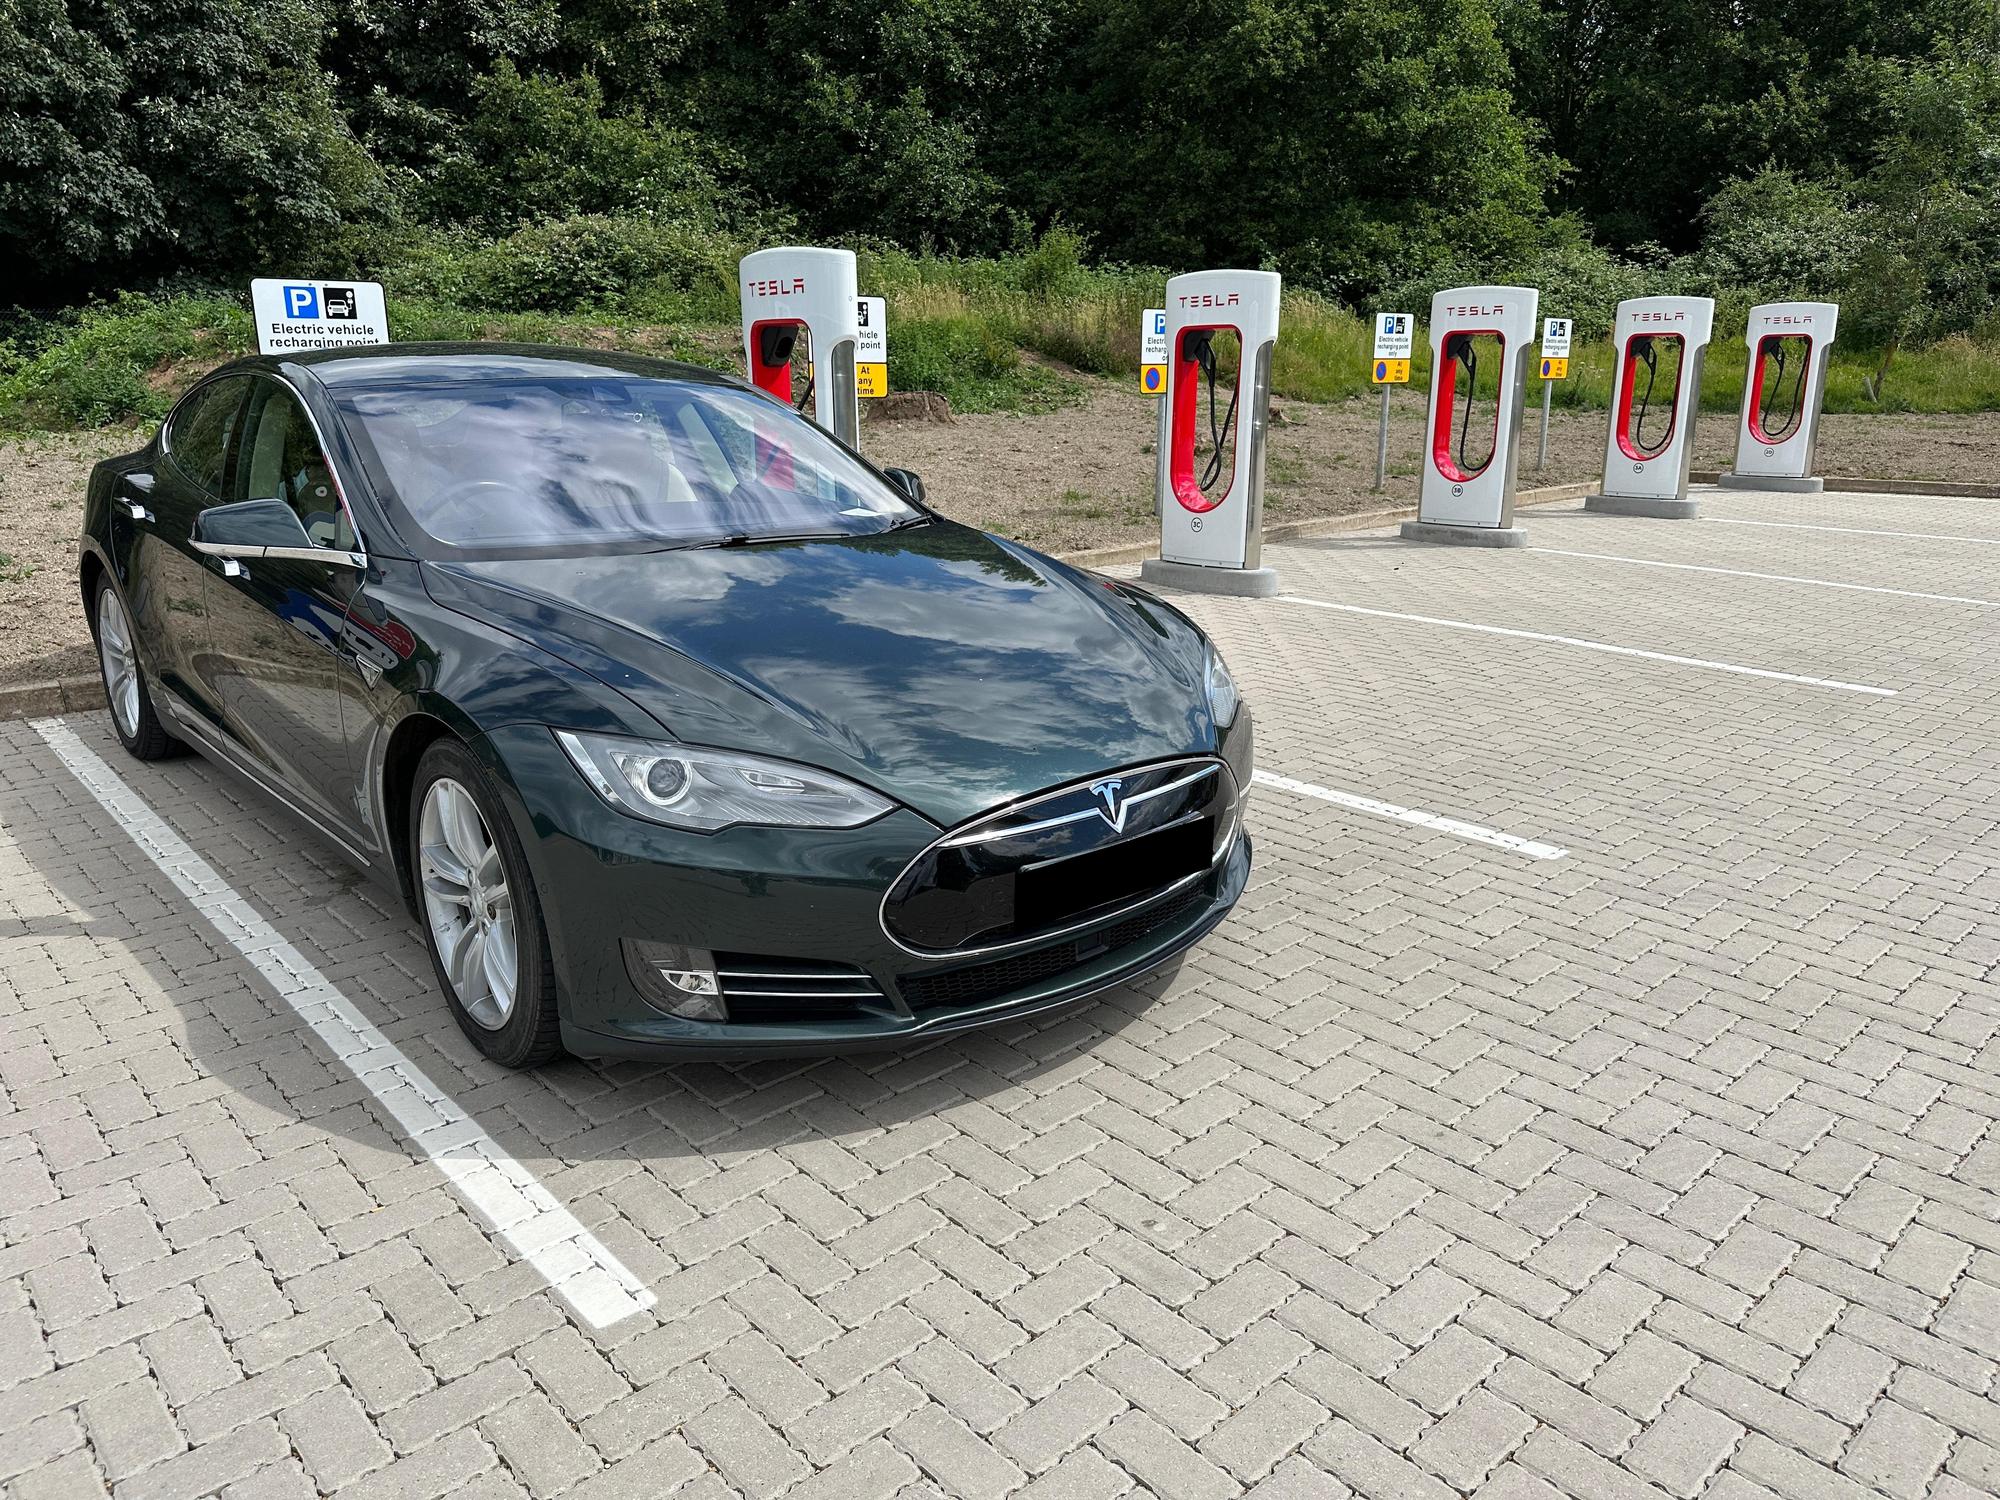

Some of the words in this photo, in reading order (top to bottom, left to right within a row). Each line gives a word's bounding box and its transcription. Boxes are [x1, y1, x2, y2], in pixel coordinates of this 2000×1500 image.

[748, 278, 805, 297] TESLA
[290, 289, 312, 316] P
[1179, 293, 1239, 308] TESLA
[1446, 305, 1504, 317] TESLA
[1631, 312, 1685, 322] TESLA
[1763, 315, 1812, 325] TESLA
[271, 323, 325, 334] Electric
[327, 324, 375, 335] vehicle
[1386, 317, 1393, 333] P
[859, 330, 878, 339] hicle
[269, 336, 342, 348] recharging
[860, 340, 881, 351] point
[1147, 337, 1166, 345] Electr
[1145, 346, 1168, 355] recharg
[860, 366, 870, 375] At
[858, 378, 873, 387] any
[857, 387, 875, 395] time
